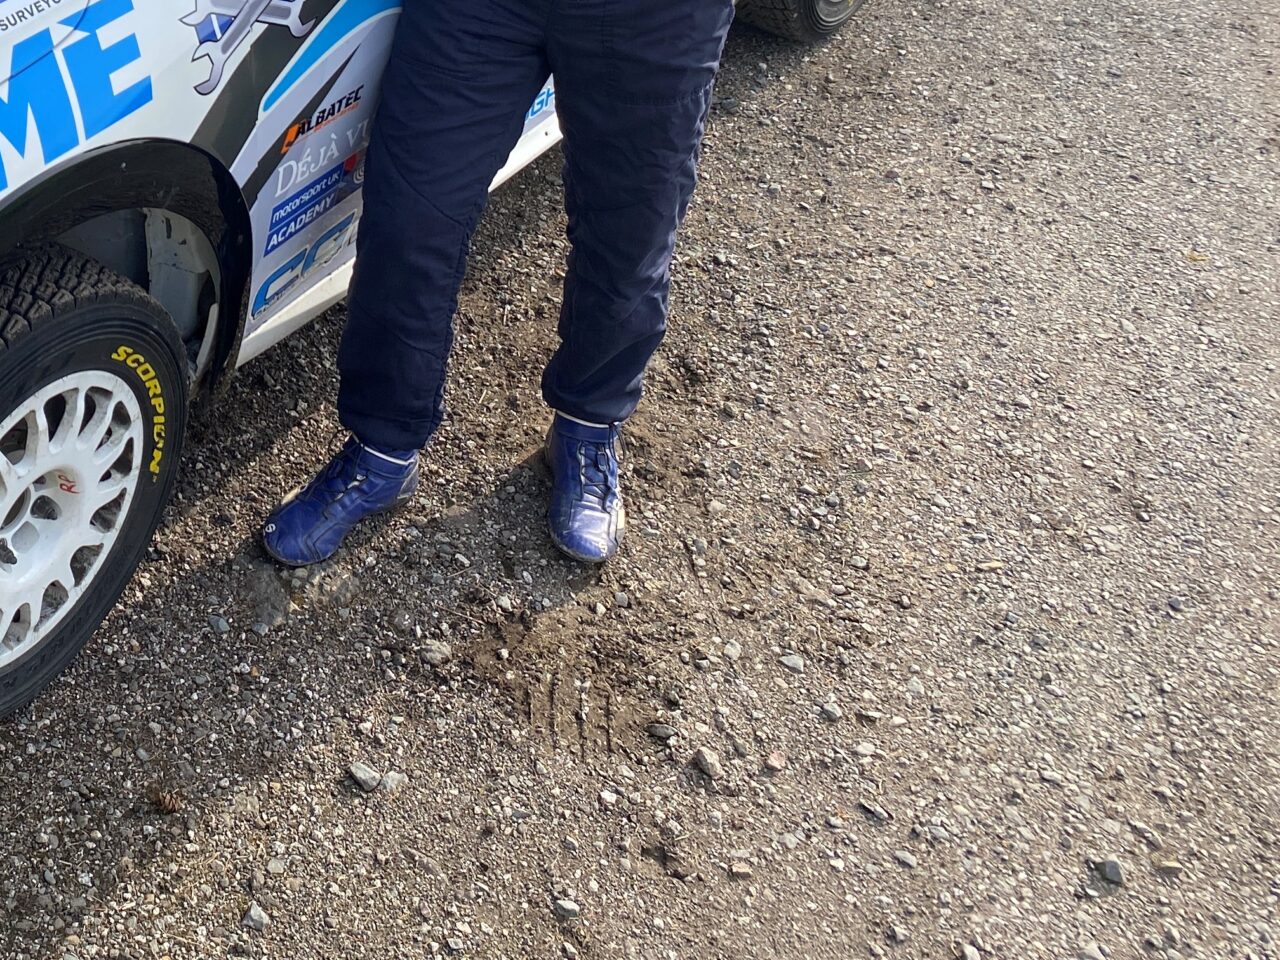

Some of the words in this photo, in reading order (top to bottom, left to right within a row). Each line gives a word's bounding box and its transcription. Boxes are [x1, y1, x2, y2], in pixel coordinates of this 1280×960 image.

[295, 84, 364, 137] ALBATEC
[267, 194, 335, 250] ACADEMY
[272, 178, 327, 223] motorsport
[328, 171, 340, 185] UK
[111, 345, 166, 474] SCORPION
